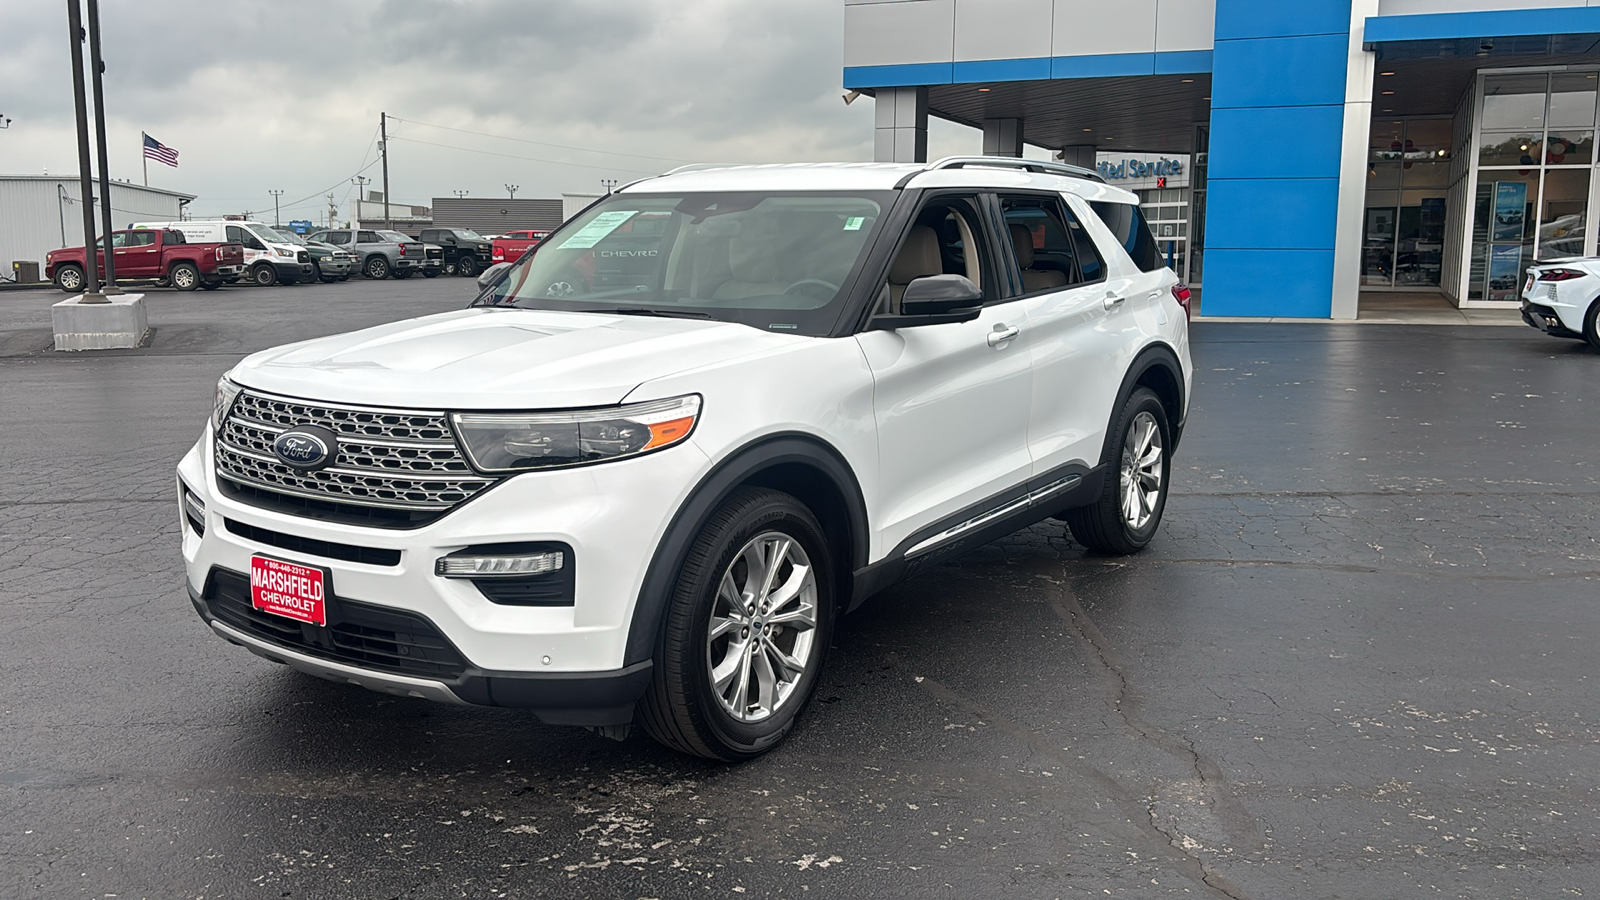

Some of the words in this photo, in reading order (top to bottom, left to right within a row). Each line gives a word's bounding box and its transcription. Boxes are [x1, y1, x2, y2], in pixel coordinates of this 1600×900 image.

[1129, 156, 1181, 178] Service
[283, 437, 313, 459] Ford
[269, 561, 306, 576] 800-440-2312
[252, 567, 322, 601] MARSHFIELD
[260, 590, 316, 613] CHEVROLET
